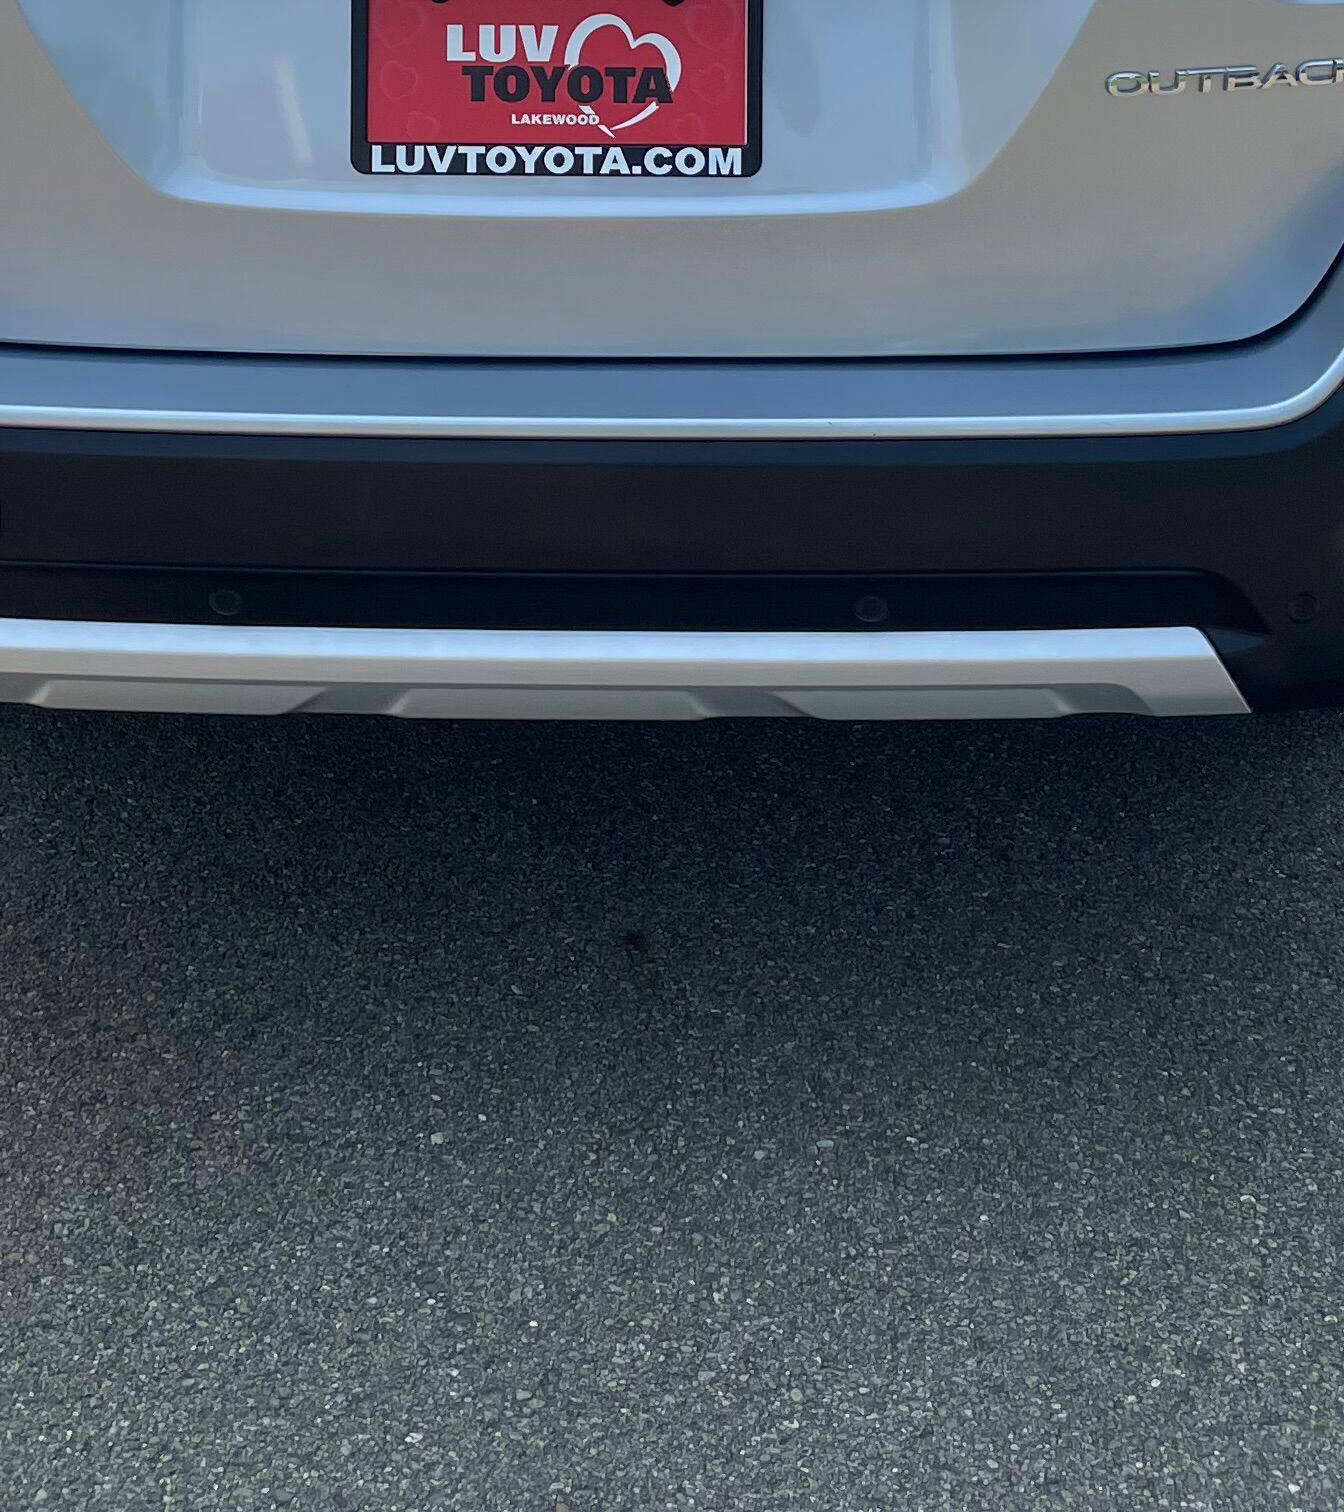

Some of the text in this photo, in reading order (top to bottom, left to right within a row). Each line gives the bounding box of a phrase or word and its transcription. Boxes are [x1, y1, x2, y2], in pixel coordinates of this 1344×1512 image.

[446, 24, 559, 62] LUV
[461, 64, 674, 104] TOYOTA
[511, 113, 600, 126] LAKEWOOD
[371, 144, 743, 176] LUVTOYOTA.COM
